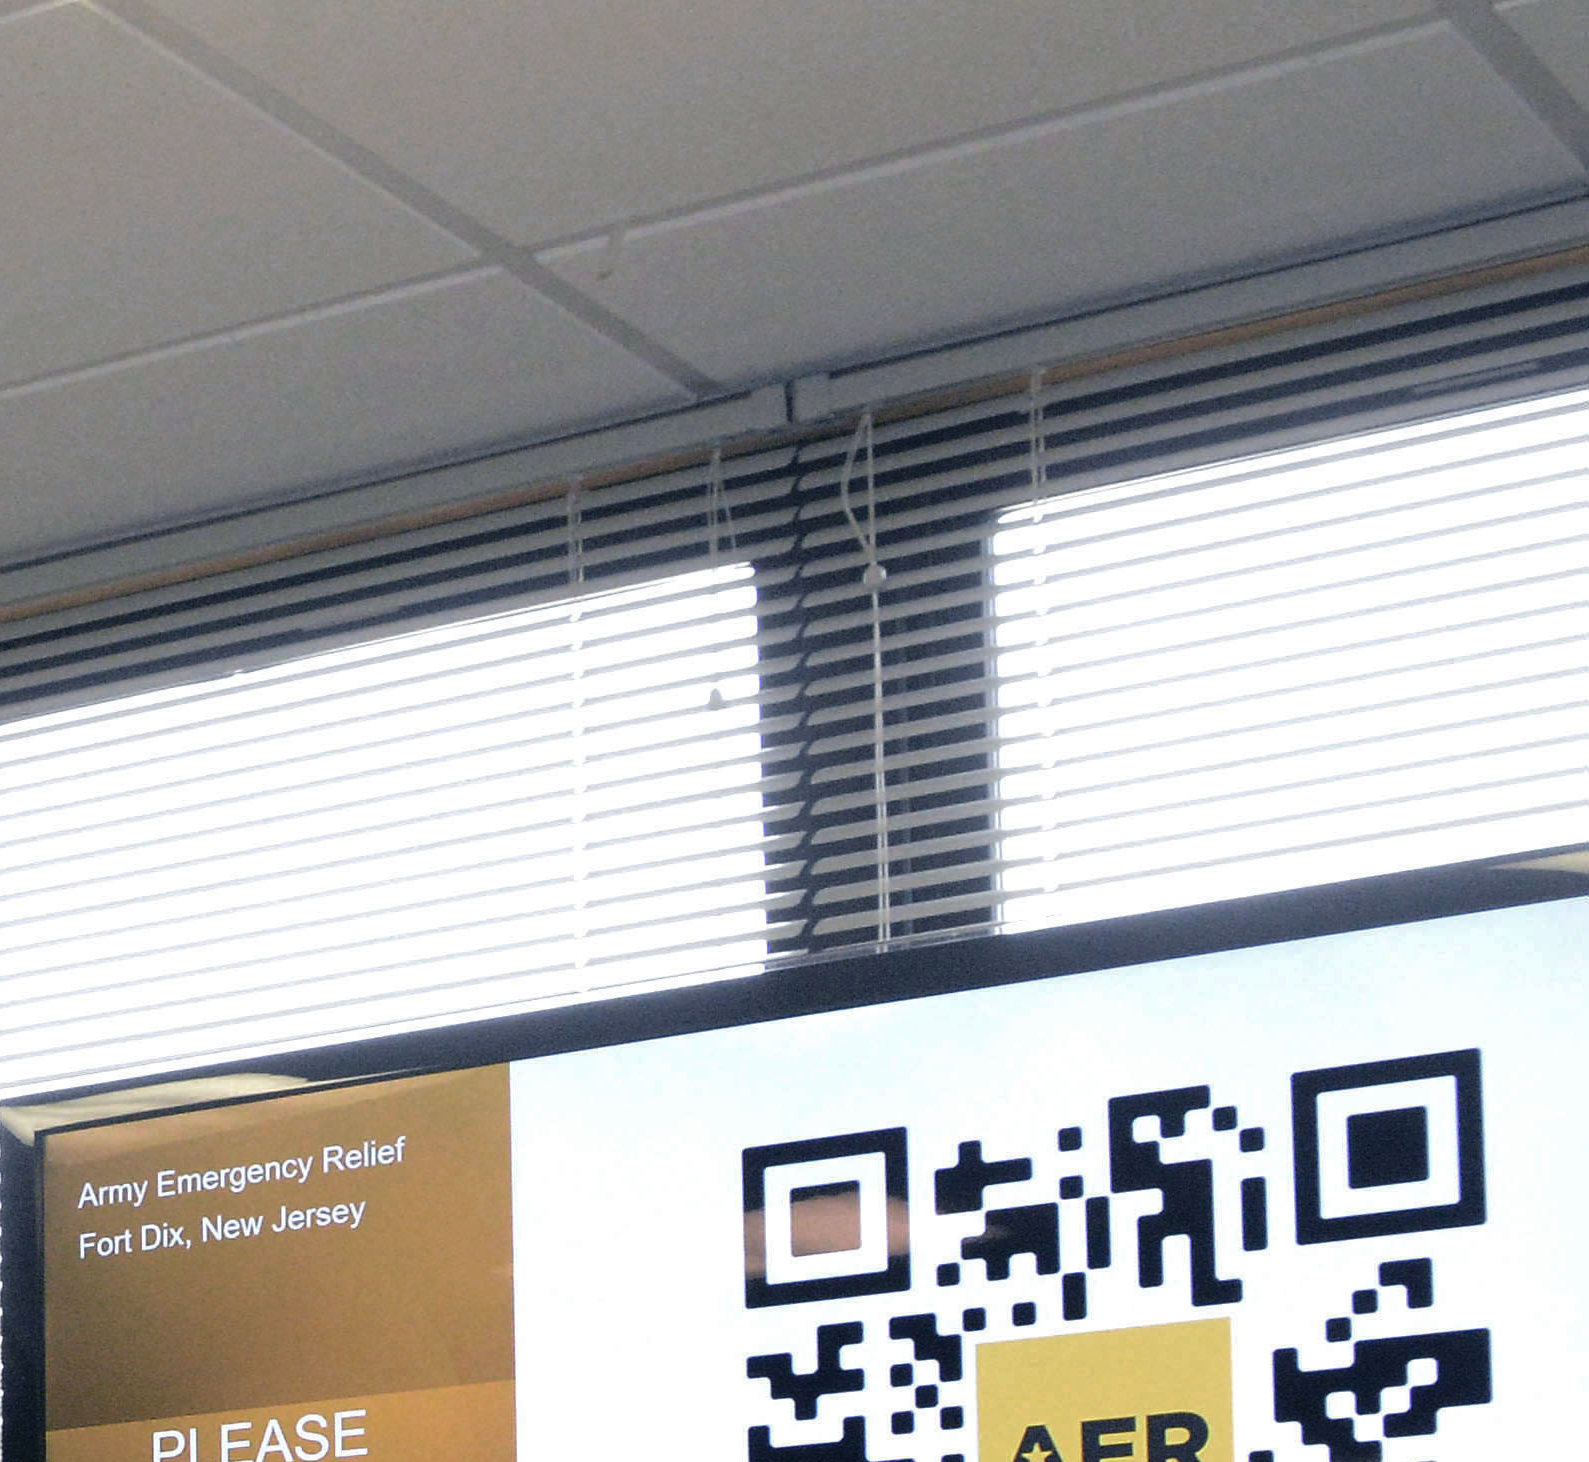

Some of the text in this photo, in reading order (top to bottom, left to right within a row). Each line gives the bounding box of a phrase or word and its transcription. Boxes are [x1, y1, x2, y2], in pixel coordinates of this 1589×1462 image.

[78, 1136, 407, 1209] Army Emergency Relief
[79, 1201, 367, 1260] Fort Dix, New Jersey
